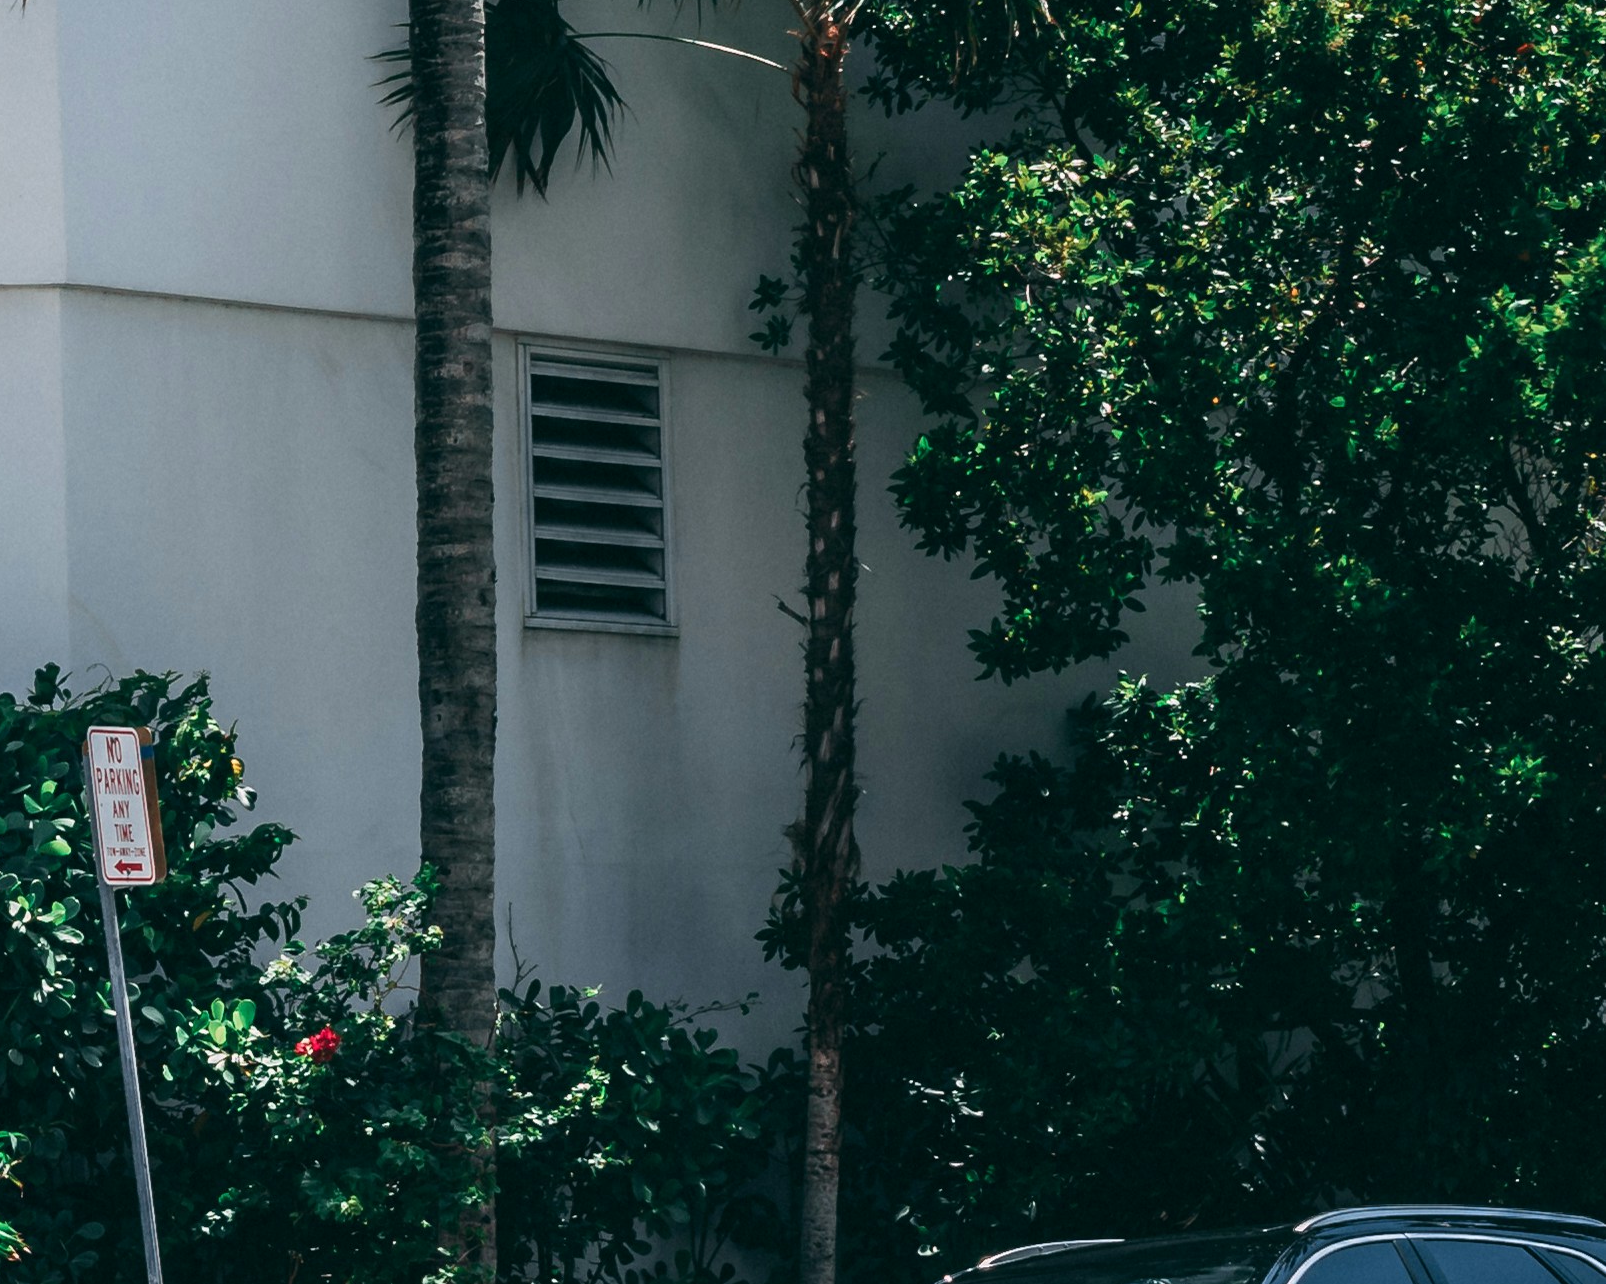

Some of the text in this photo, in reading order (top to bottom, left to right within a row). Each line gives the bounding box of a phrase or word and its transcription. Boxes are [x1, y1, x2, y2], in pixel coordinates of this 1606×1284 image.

[105, 736, 123, 764] NO
[96, 767, 140, 795] PARKING
[112, 800, 130, 818] ANY
[114, 824, 134, 843] TIME
